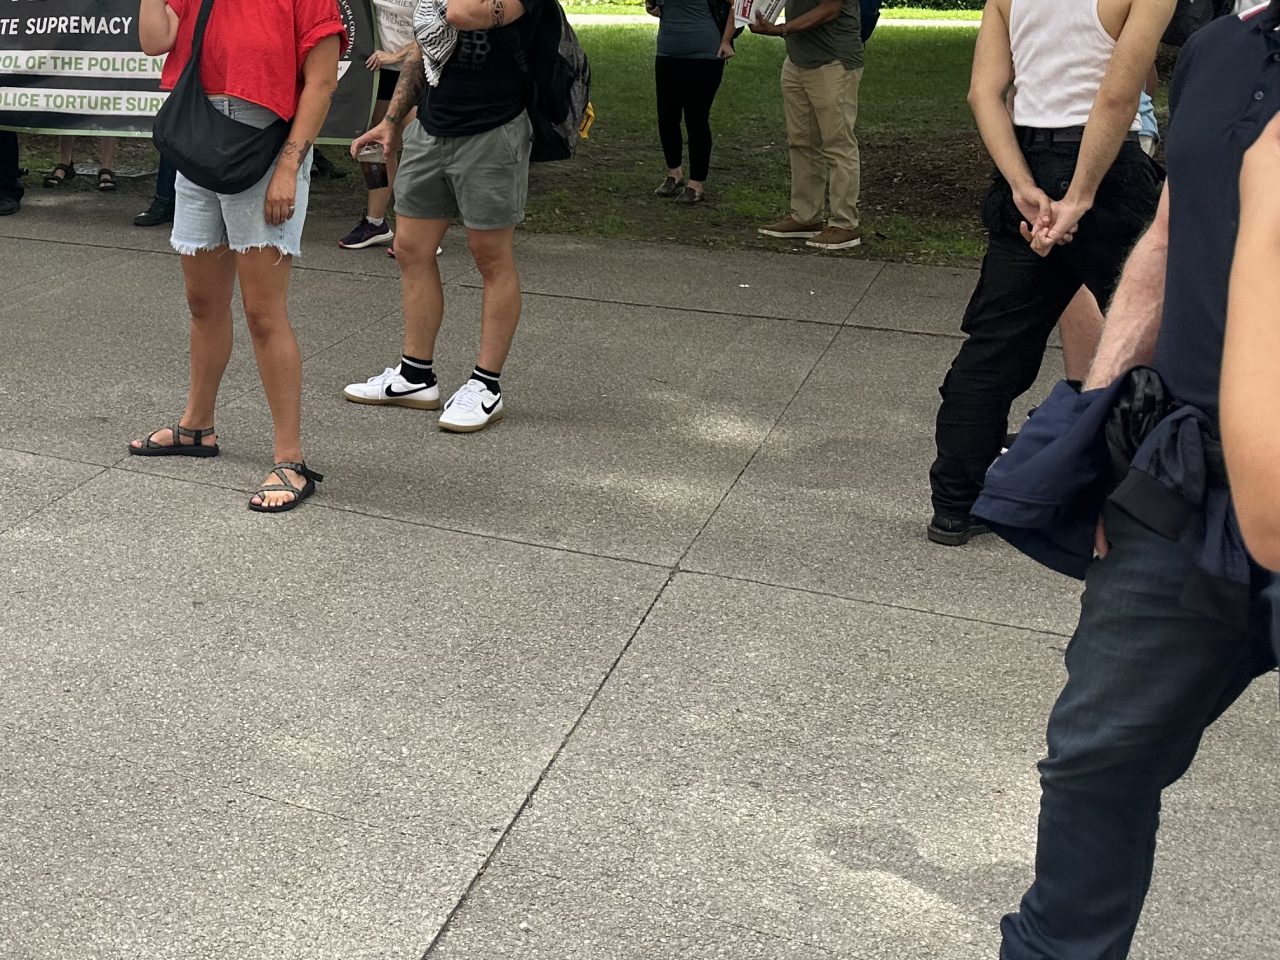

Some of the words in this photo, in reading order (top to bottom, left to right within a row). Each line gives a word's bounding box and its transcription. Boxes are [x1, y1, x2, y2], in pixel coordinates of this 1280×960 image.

[25, 16, 133, 35] SUPREMACY
[343, 21, 356, 59] CONTINUA
[25, 55, 47, 70] OF
[50, 56, 84, 71] THE
[88, 57, 148, 72] POLICE
[44, 94, 124, 111] TORTURE
[126, 97, 165, 112] SUR
